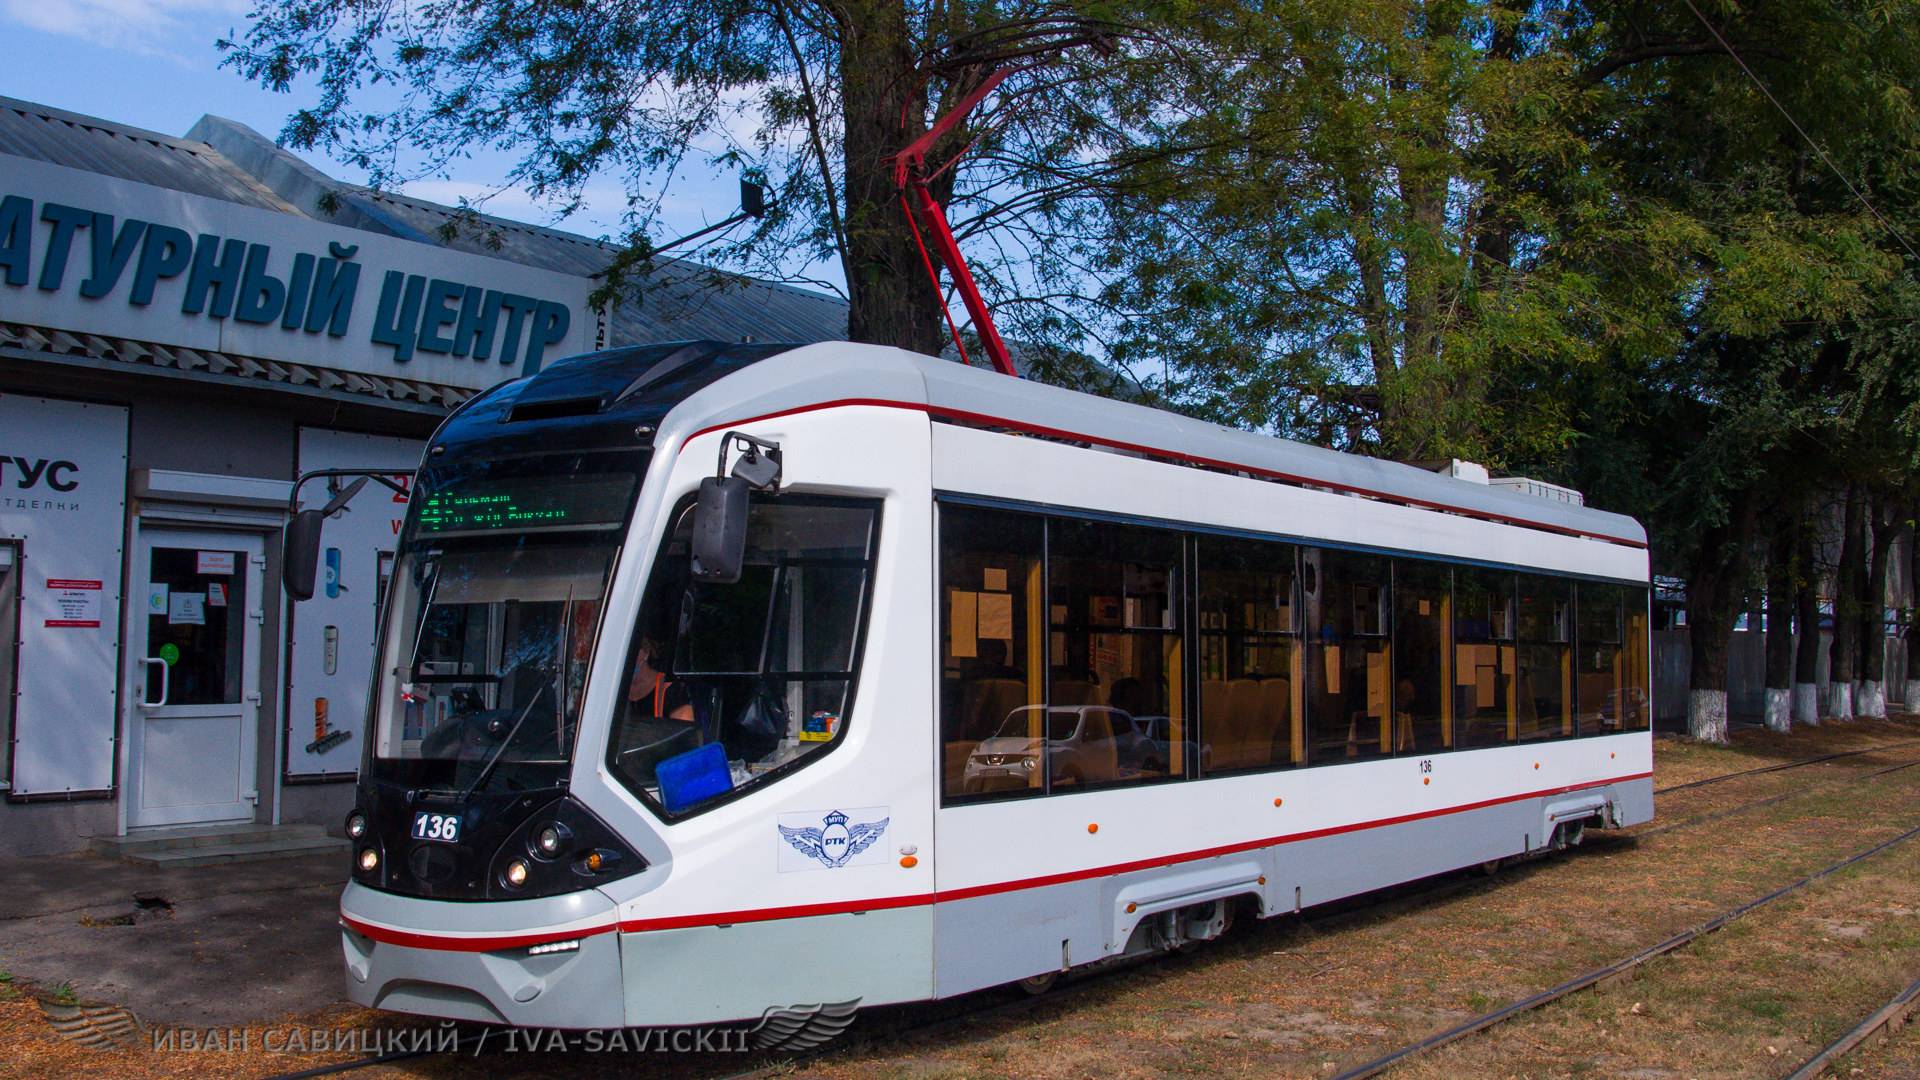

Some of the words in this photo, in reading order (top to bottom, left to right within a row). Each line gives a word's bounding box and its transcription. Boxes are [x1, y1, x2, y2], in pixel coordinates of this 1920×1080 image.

[0, 194, 362, 338] АТУРНЫЙ
[371, 269, 571, 377] ЦЕНТР
[1420, 760, 1432, 773] 136
[417, 814, 458, 840] 136
